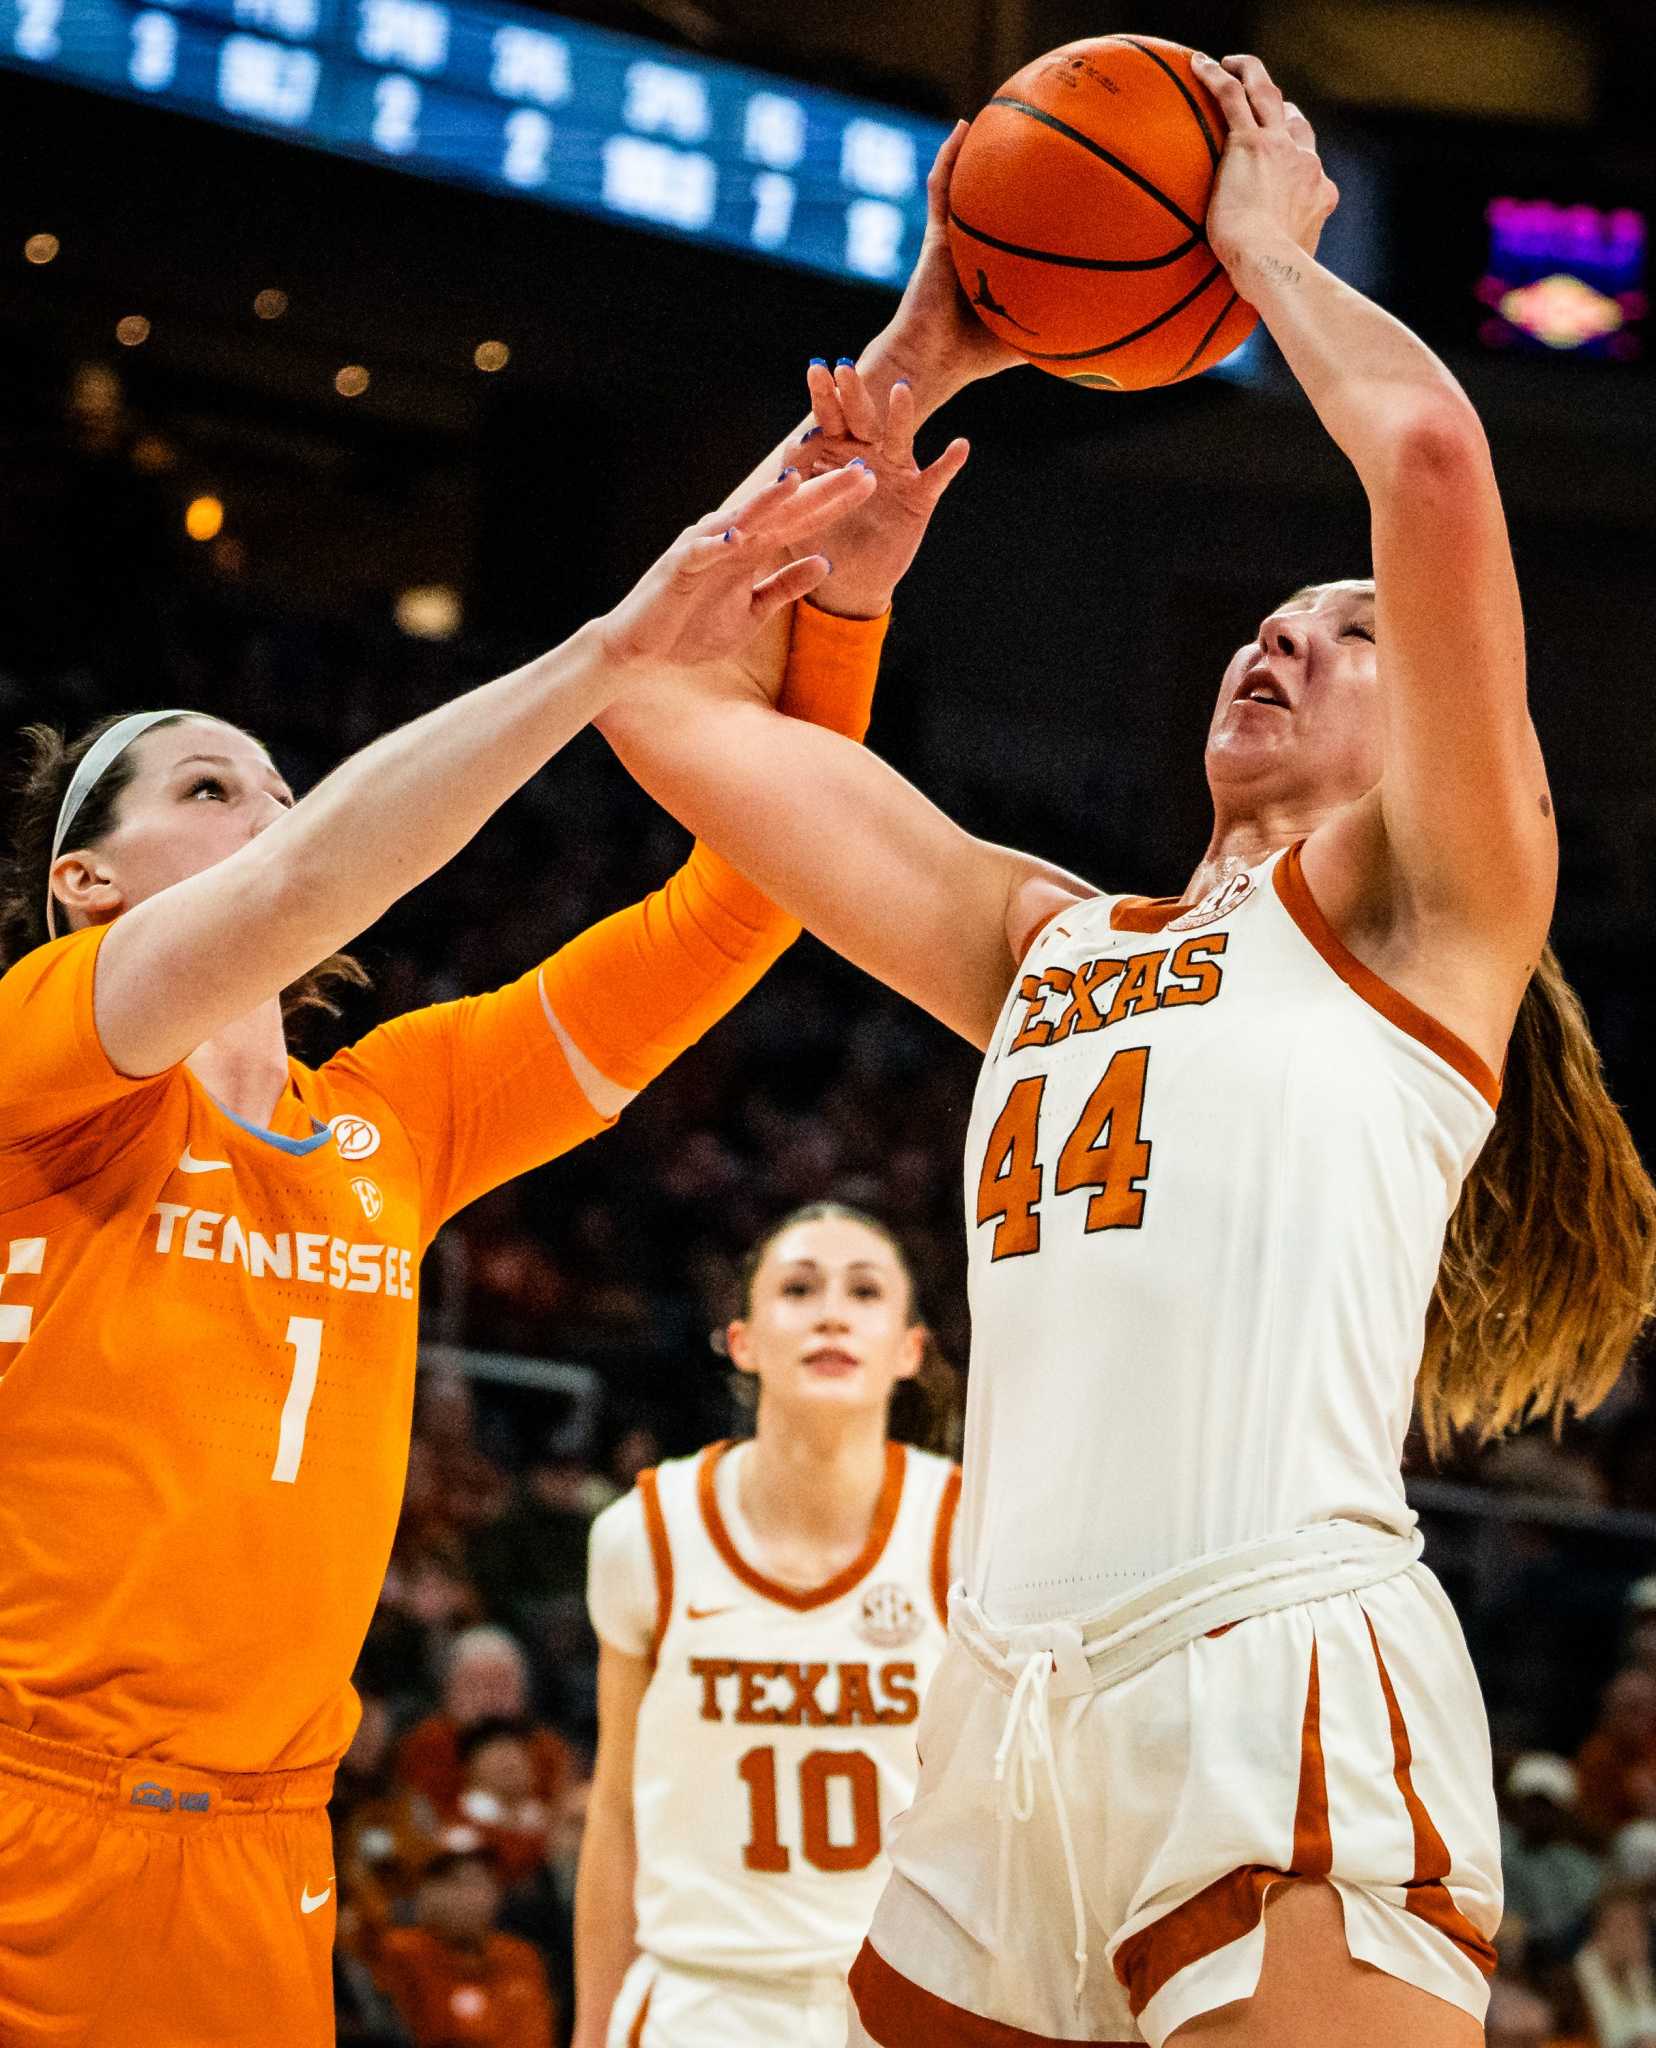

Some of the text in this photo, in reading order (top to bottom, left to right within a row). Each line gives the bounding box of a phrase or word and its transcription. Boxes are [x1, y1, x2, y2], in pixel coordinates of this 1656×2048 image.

[976, 1046, 1152, 1263] 44
[153, 1201, 413, 1300] TENNESSEE
[271, 1316, 323, 1484] 1
[689, 1655, 920, 1726] TEXAS
[738, 1745, 882, 1873] 10
